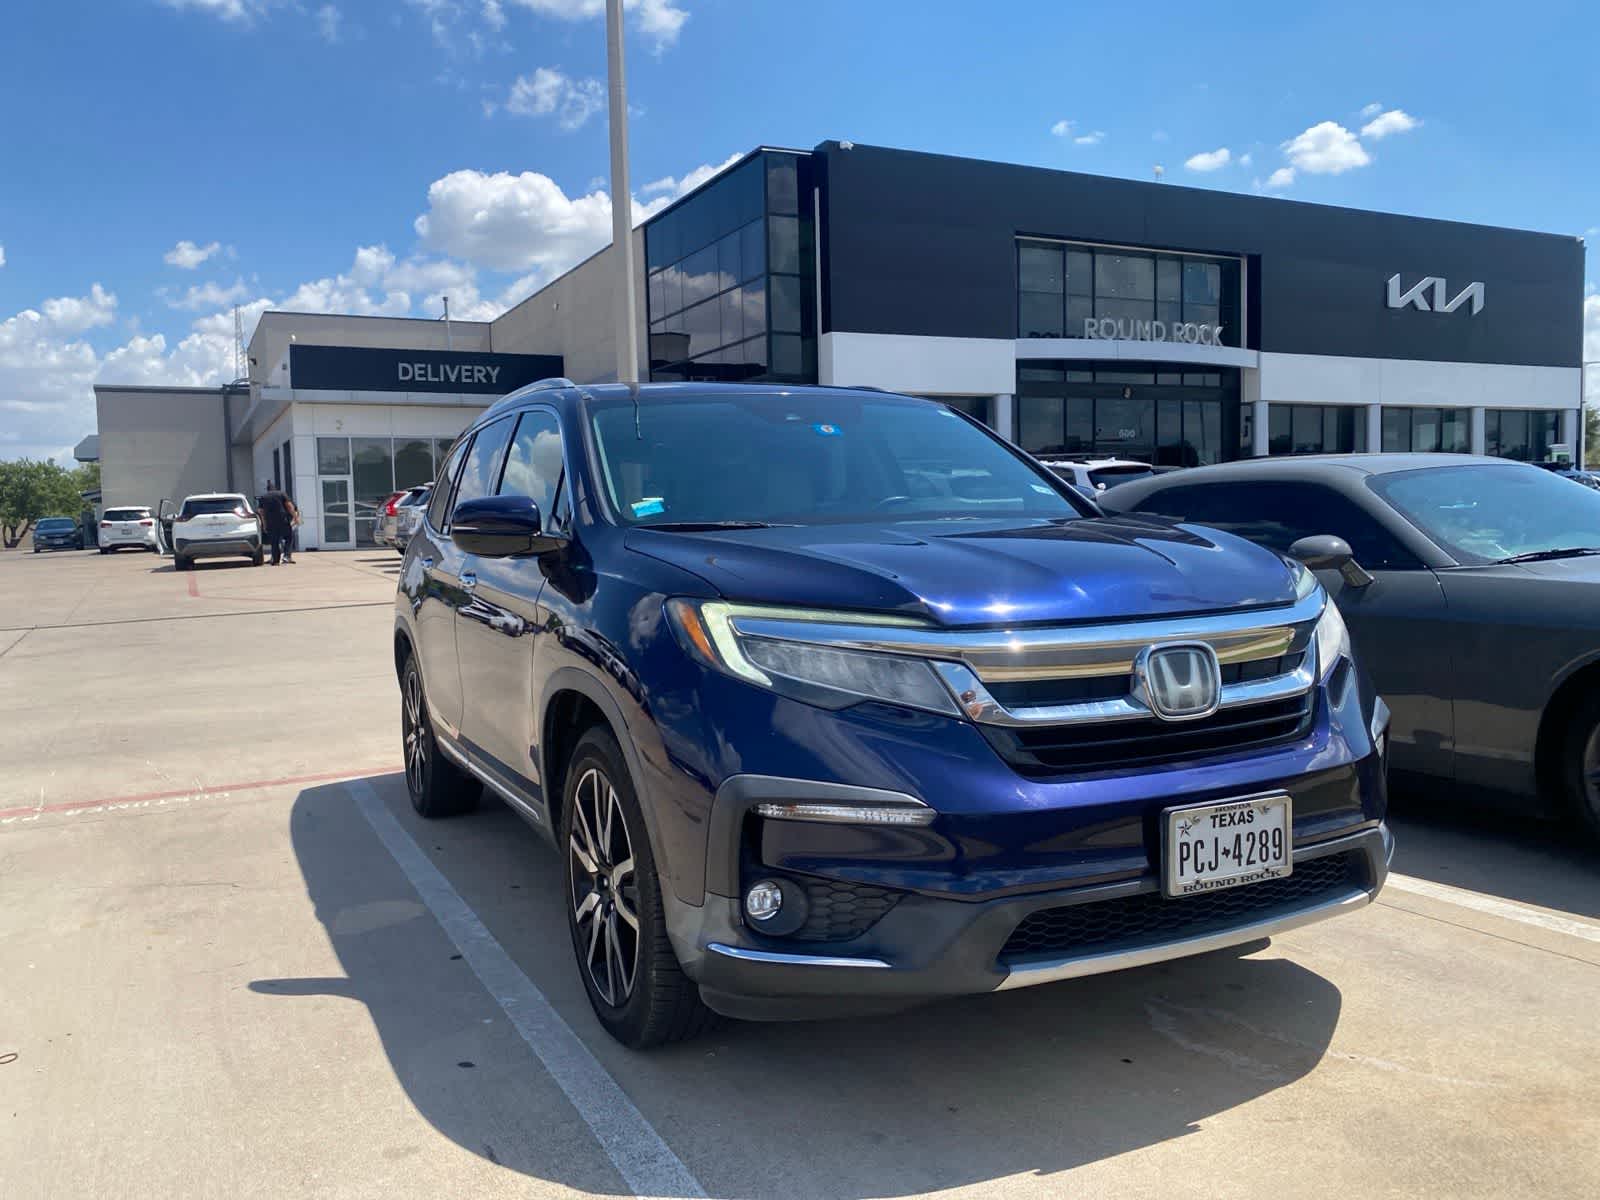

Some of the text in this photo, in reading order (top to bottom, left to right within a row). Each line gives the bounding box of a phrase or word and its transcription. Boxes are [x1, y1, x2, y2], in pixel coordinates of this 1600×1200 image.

[1387, 272, 1485, 316] KIA
[1083, 317, 1224, 346] ROUND ROCK
[398, 362, 500, 384] DELIVERY
[1210, 809, 1254, 829] TEXAS
[1183, 869, 1281, 893] ROUND ROCK
